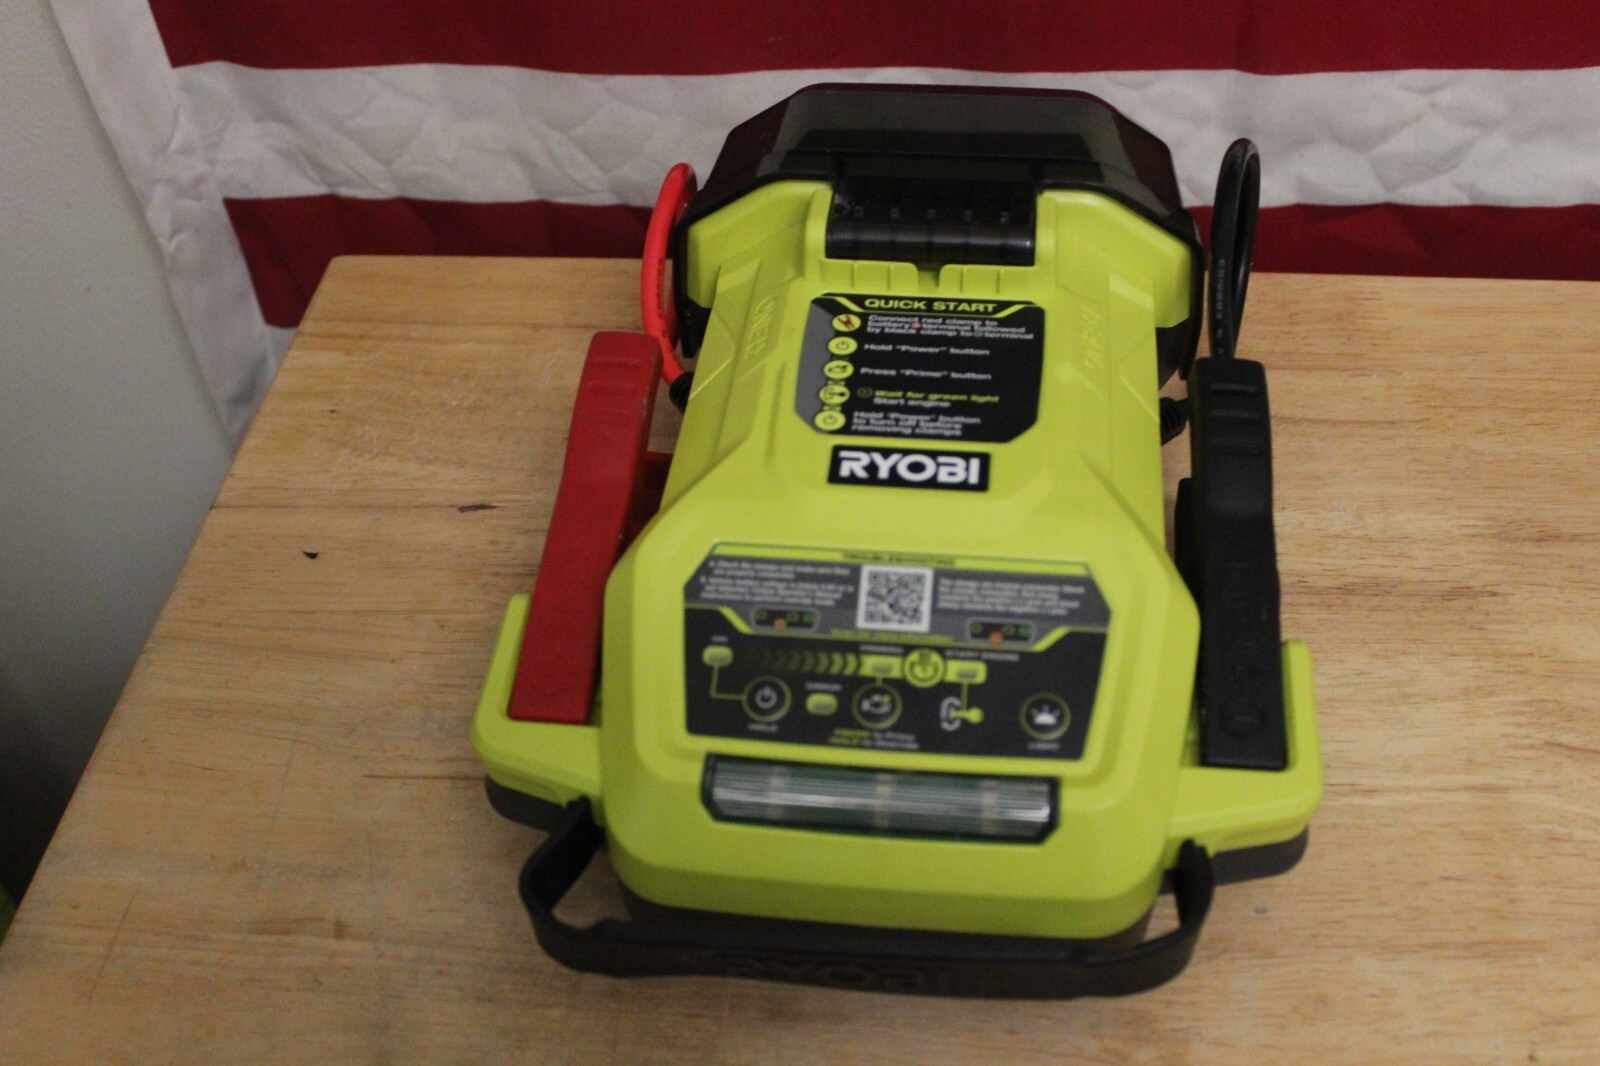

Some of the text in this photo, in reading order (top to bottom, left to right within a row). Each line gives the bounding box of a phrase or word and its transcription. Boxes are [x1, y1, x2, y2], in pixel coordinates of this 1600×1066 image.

[864, 298, 998, 313] QUICK START
[867, 320, 1026, 334] battery terminal followed
[868, 314, 998, 328] Connect red clamp to
[866, 326, 1034, 340] by black clamp to terminal
[863, 342, 893, 352] Hold
[949, 346, 990, 356] button
[860, 366, 898, 376] Press
[950, 371, 992, 380] button
[873, 396, 951, 408] Start engine
[874, 389, 1000, 403] Wait for green light
[852, 417, 867, 426] to
[869, 418, 896, 427] turn
[919, 420, 963, 430] before
[853, 411, 885, 420] Hold
[938, 414, 981, 424] button
[838, 449, 981, 485] RYOBI
